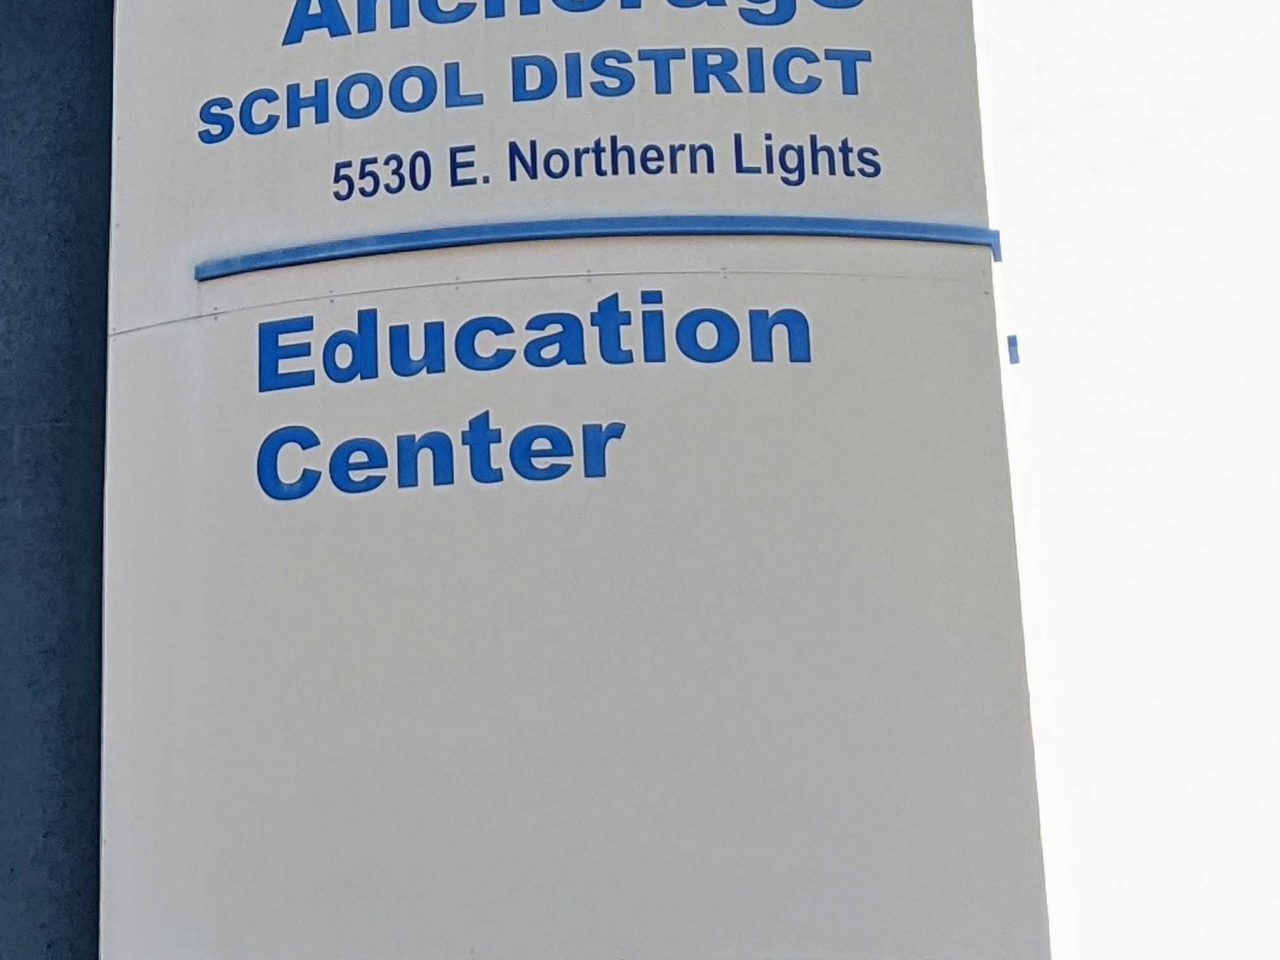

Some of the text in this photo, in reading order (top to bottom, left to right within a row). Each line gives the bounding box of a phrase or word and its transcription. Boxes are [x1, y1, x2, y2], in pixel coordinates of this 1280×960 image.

[197, 47, 874, 147] SCHOOL DISTRICT
[332, 133, 883, 203] 5530 E. Northern Lights
[257, 290, 814, 394] Education
[256, 409, 627, 503] Center
